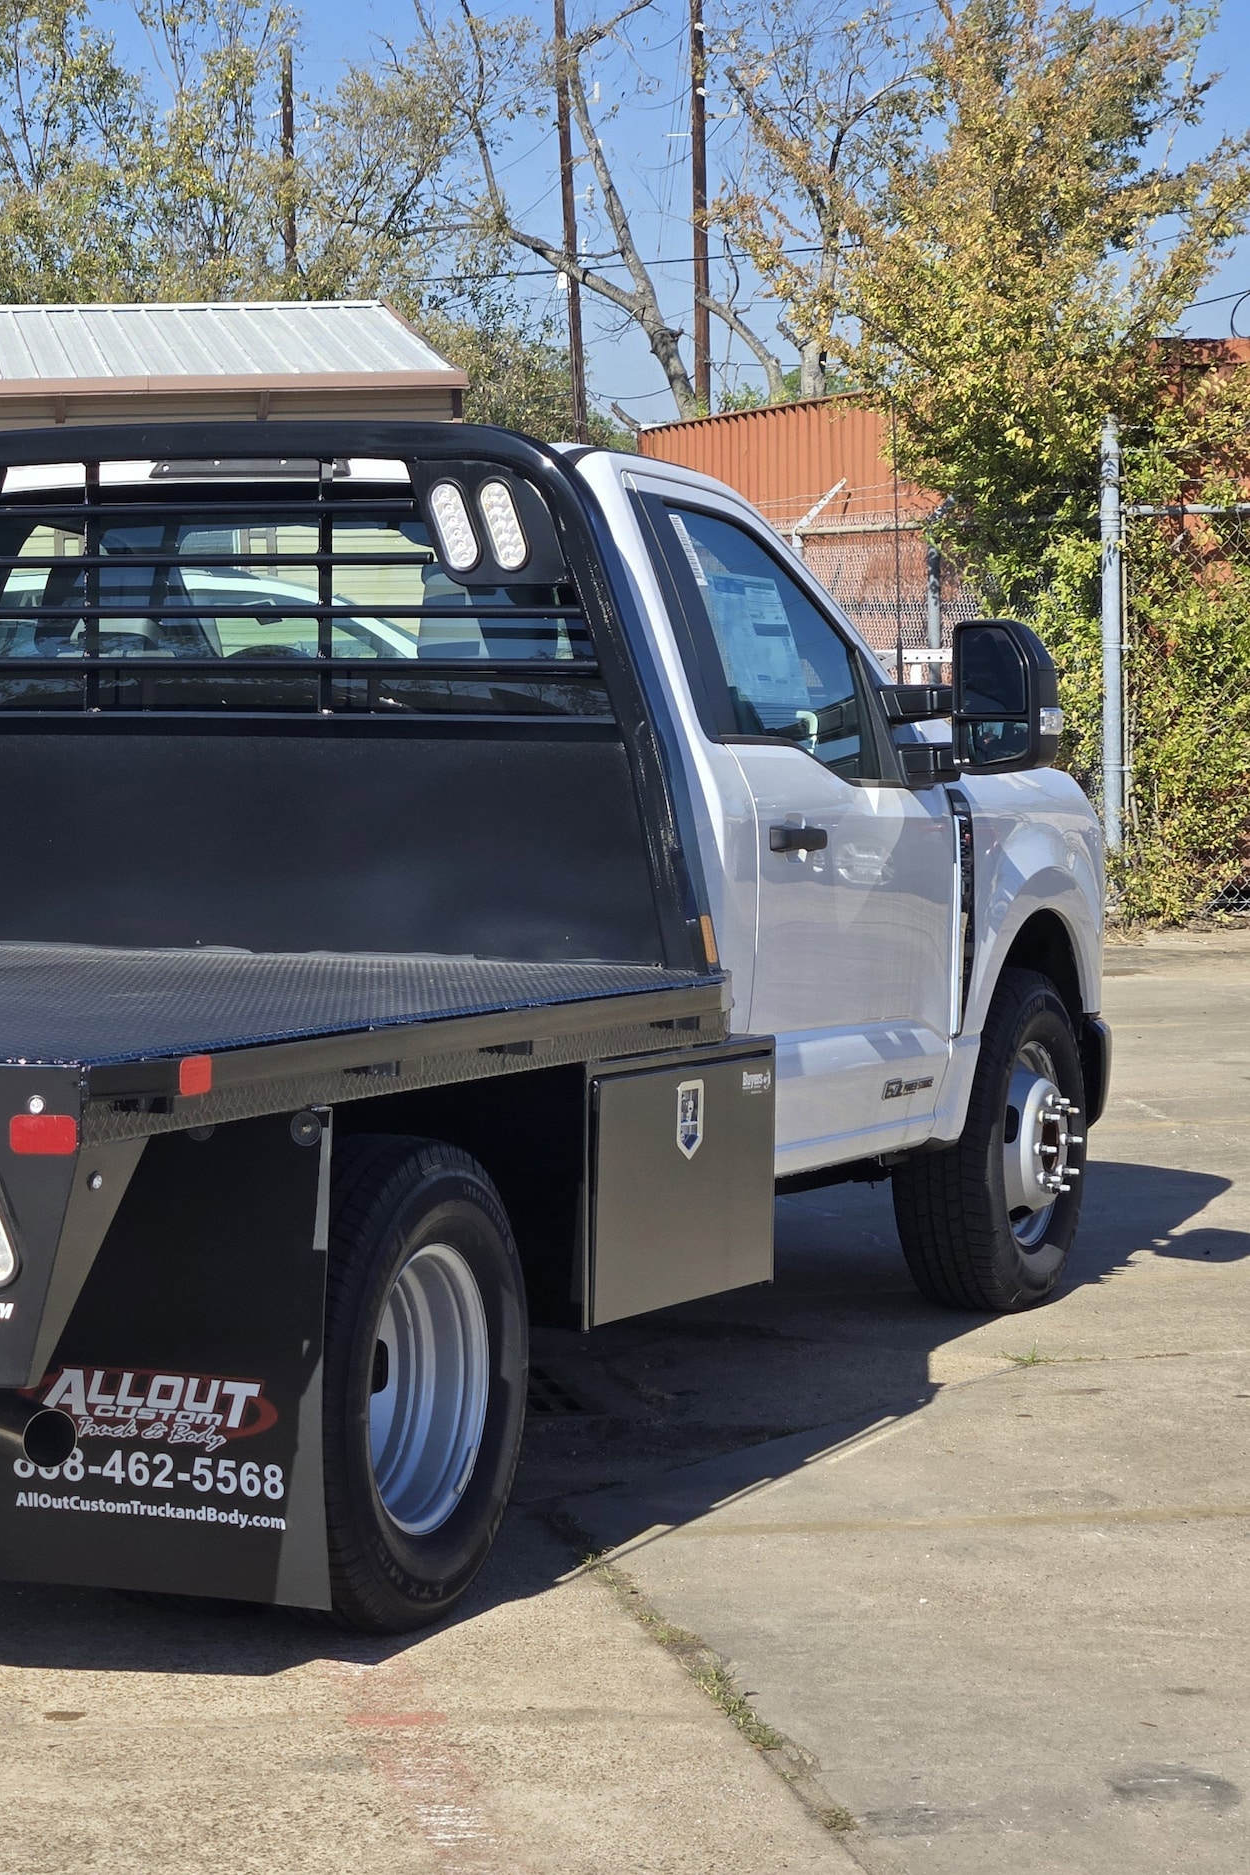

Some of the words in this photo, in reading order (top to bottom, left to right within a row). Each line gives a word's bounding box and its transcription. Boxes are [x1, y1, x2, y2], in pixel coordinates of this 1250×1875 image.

[42, 1367, 261, 1429] ALLOUT
[93, 1404, 224, 1426] CUSTOM
[78, 1416, 138, 1438] Truck
[141, 1421, 168, 1440] &
[168, 1423, 227, 1452] Body
[16, 1491, 287, 1531] AllOutCustomTruckandBody.com
